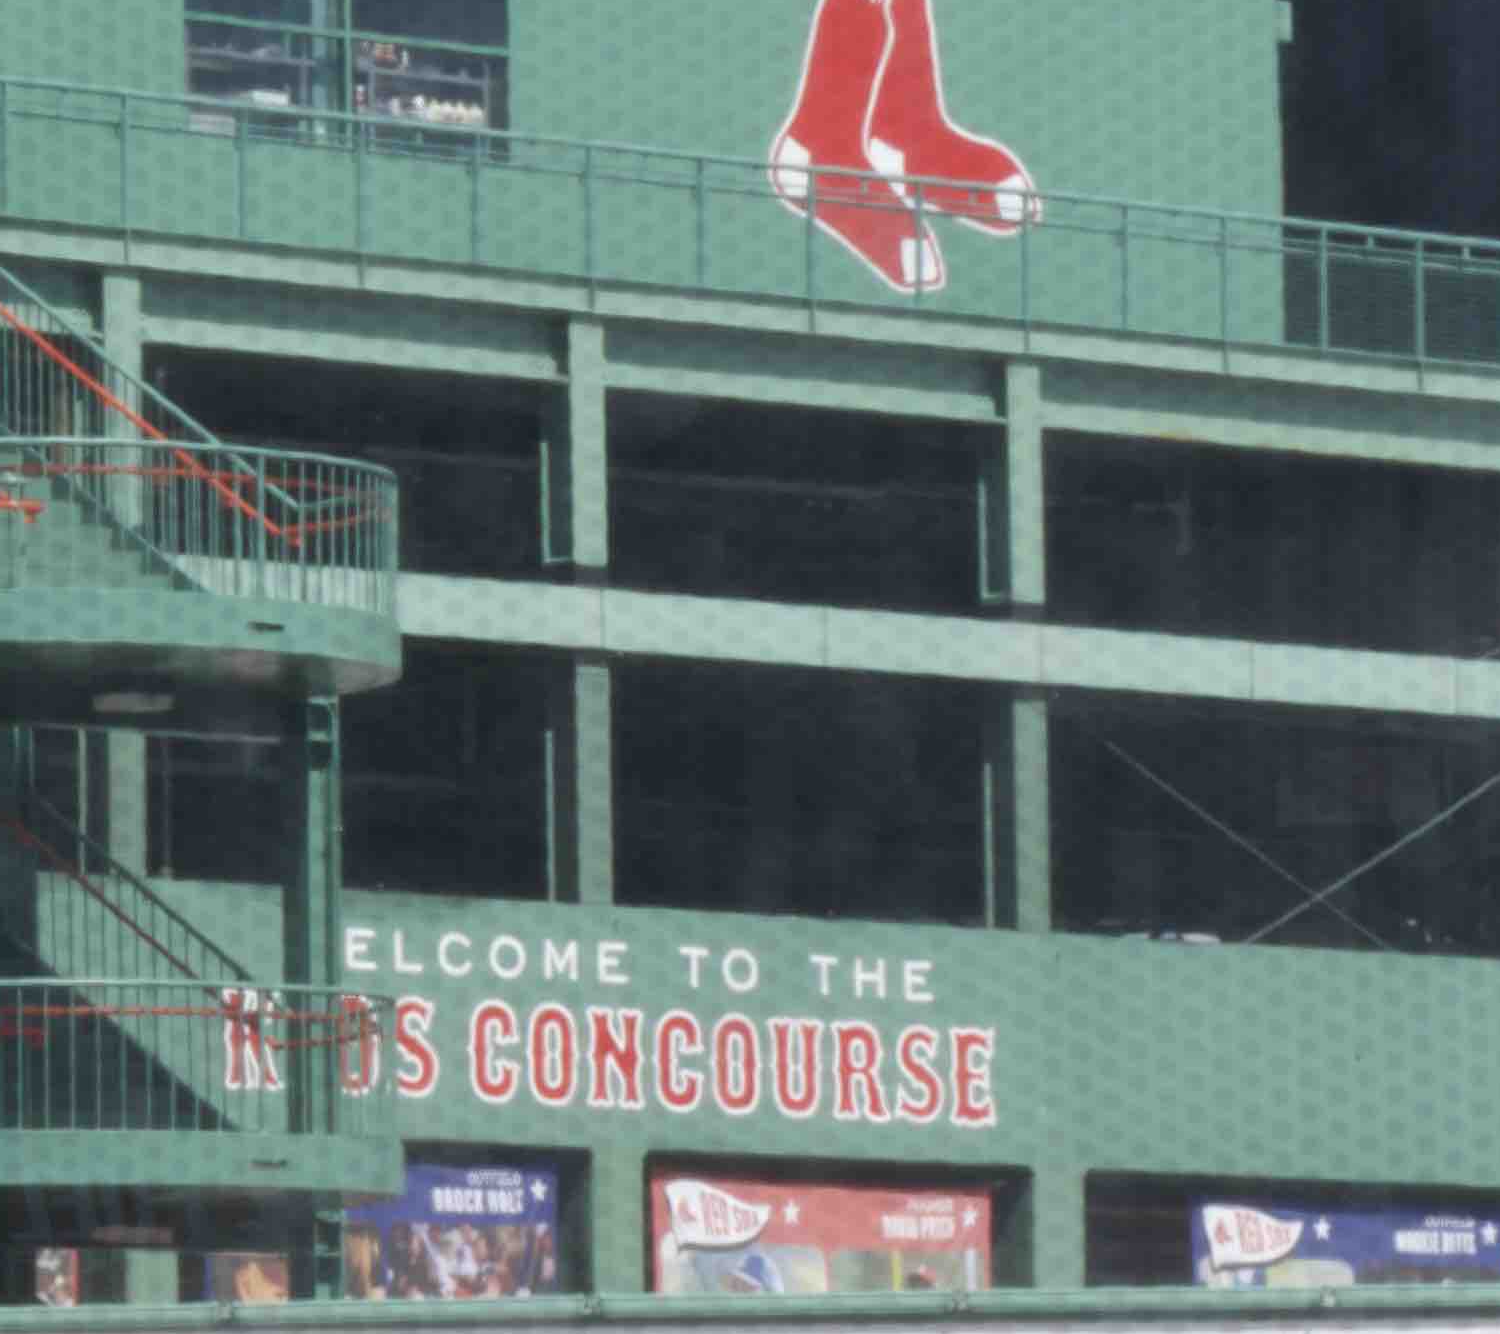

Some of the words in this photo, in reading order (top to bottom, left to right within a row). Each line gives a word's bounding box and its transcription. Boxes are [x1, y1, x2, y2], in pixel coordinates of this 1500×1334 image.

[344, 926, 632, 986] ELCOME
[680, 946, 763, 993] TO
[811, 953, 937, 1004] THE
[222, 987, 440, 1098] KDS
[467, 998, 998, 1129] CONCOURSE
